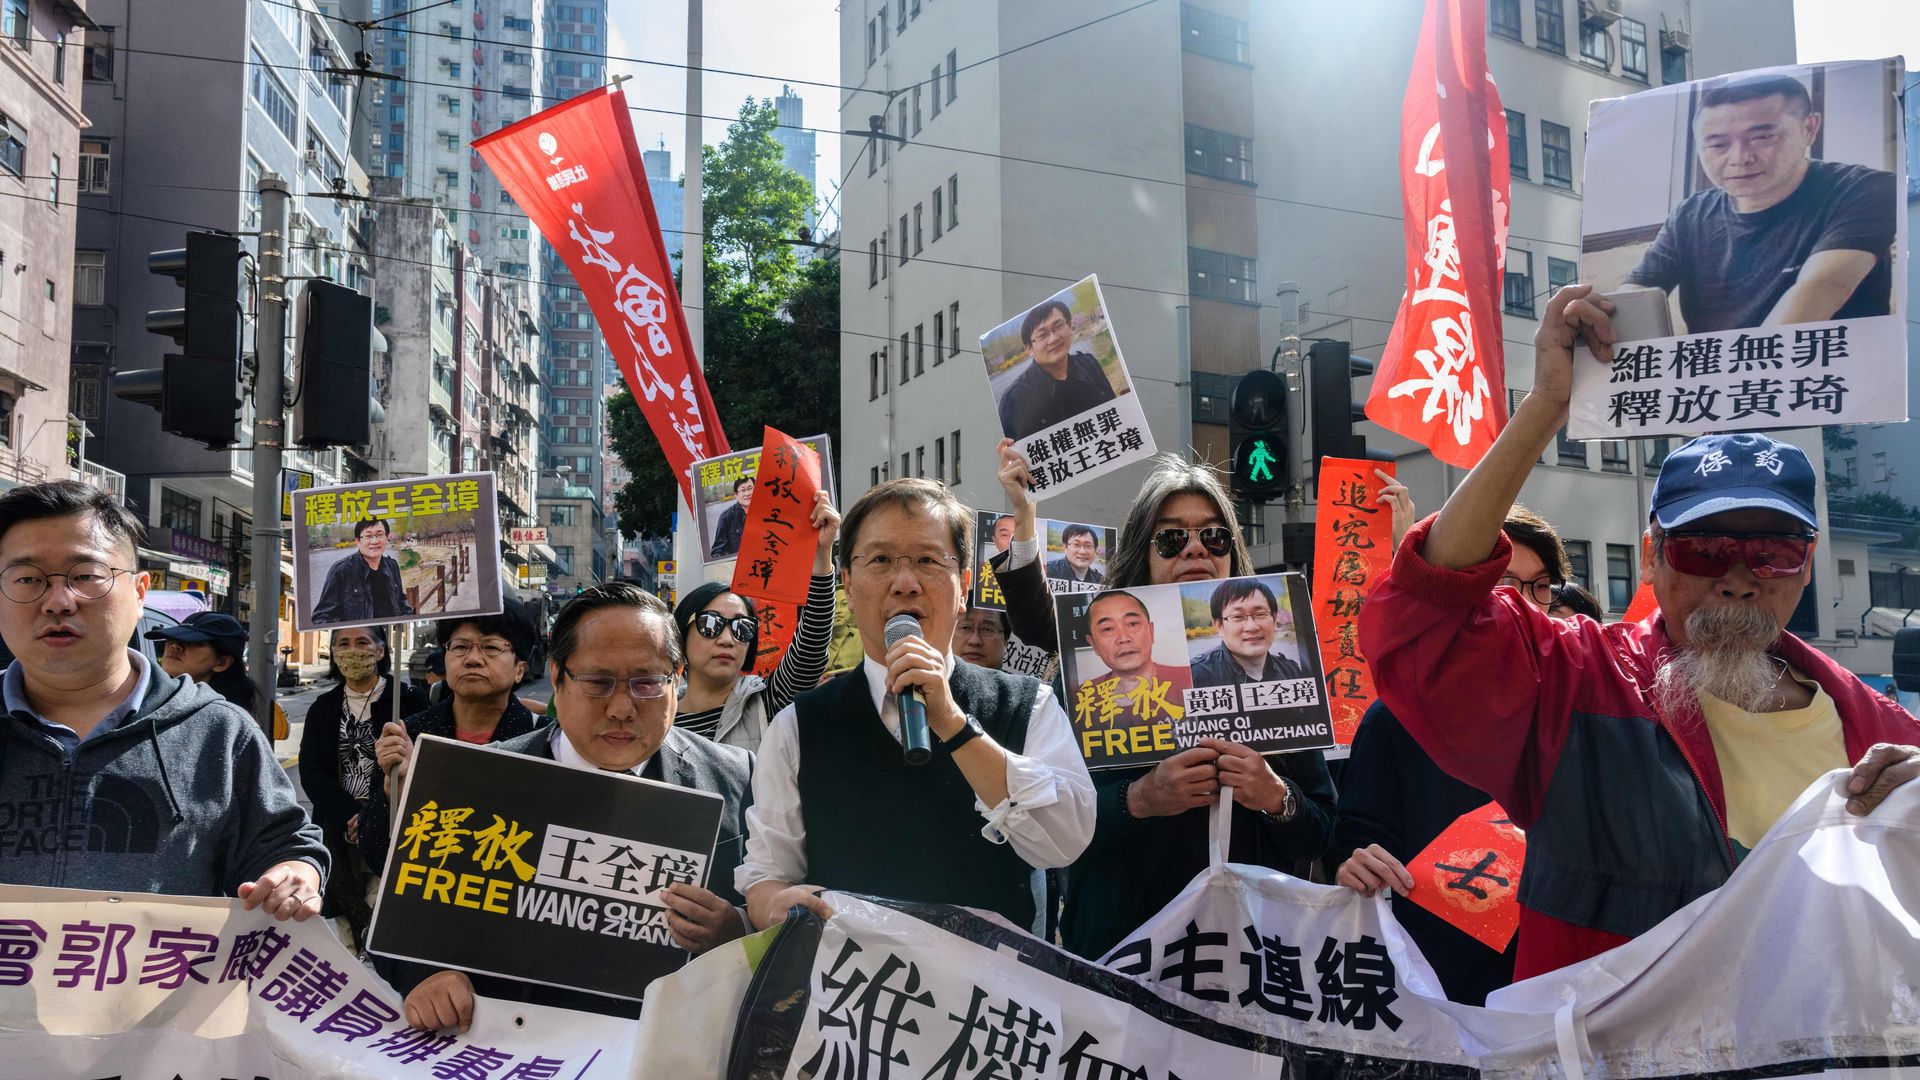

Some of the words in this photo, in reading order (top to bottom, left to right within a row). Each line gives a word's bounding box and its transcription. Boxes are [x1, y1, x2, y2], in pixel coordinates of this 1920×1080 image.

[1610, 325, 1850, 384] 維權無罪
[1607, 375, 1850, 428] 釋放黃琦
[1026, 407, 1123, 466] 維權無罪
[1027, 427, 1145, 494] 釋放王全璋
[304, 480, 480, 527] 釋放王全璋
[1074, 676, 1184, 729] 釋放
[1185, 688, 1235, 714] 黃琦
[1242, 680, 1318, 707] 王全璋
[1081, 723, 1175, 758] FREE
[1174, 719, 1230, 735] HUANG
[1234, 716, 1251, 729] QI
[1229, 722, 1328, 744] QUANZHANG
[398, 800, 538, 882] 釋放
[540, 834, 699, 895] 王全璋
[394, 862, 514, 914] FREE
[516, 885, 600, 932] WANG
[603, 901, 670, 929] QUA
